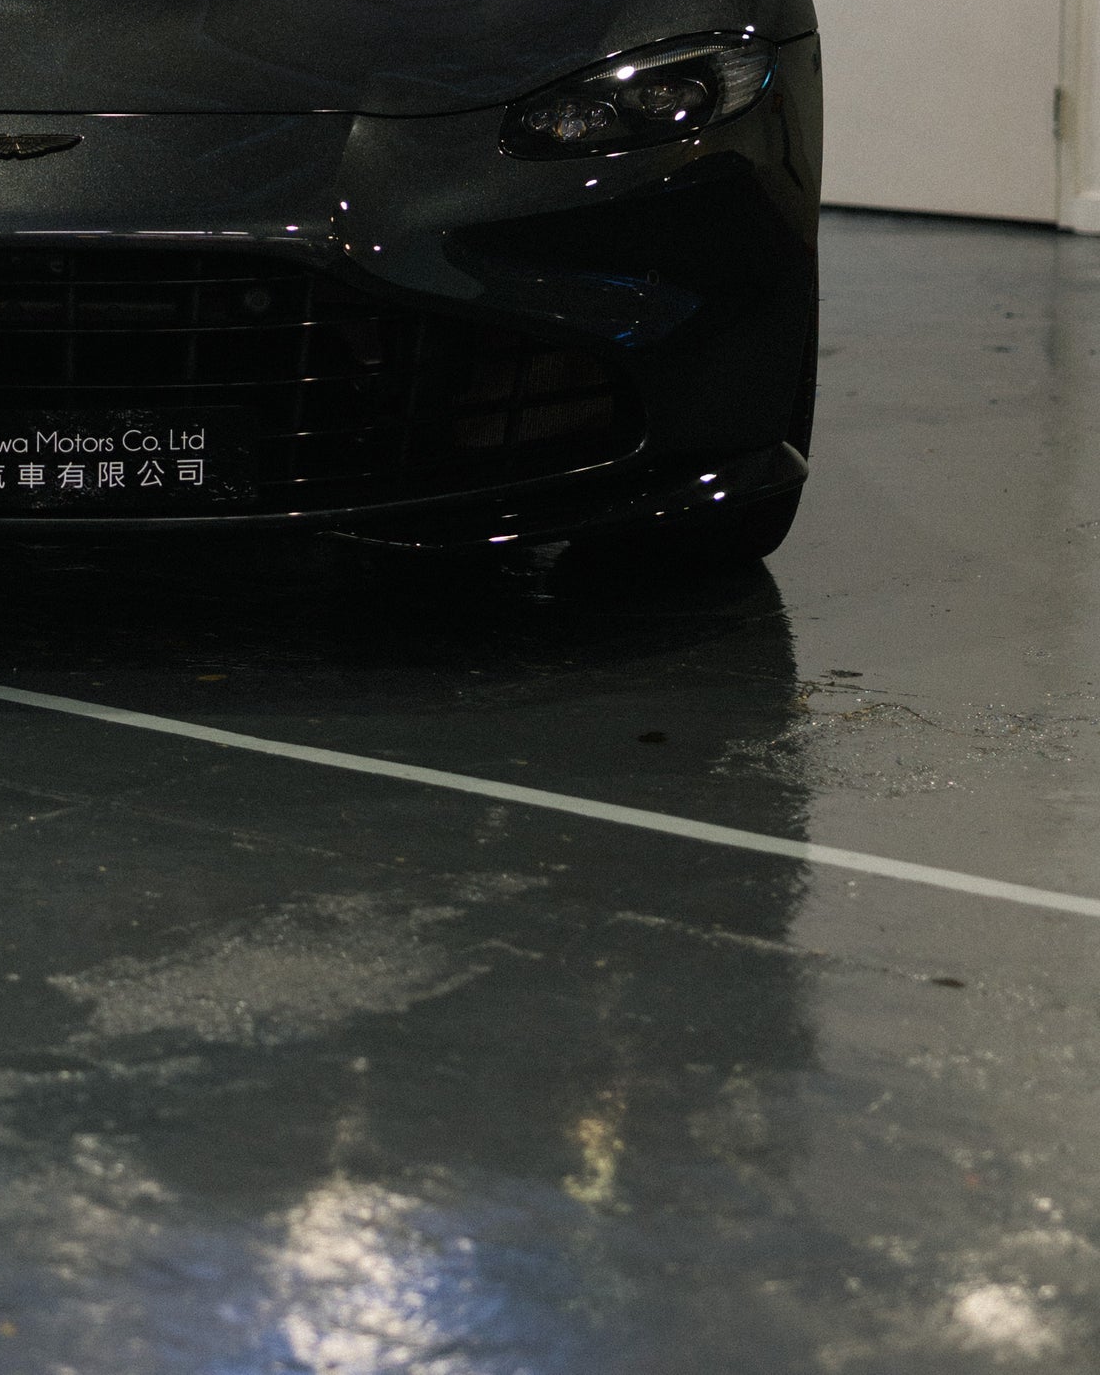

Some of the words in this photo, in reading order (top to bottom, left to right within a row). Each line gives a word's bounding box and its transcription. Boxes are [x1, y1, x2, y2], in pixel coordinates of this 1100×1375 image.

[36, 429, 114, 453] Motors
[122, 429, 162, 452] Co.
[169, 428, 206, 451] Ltd
